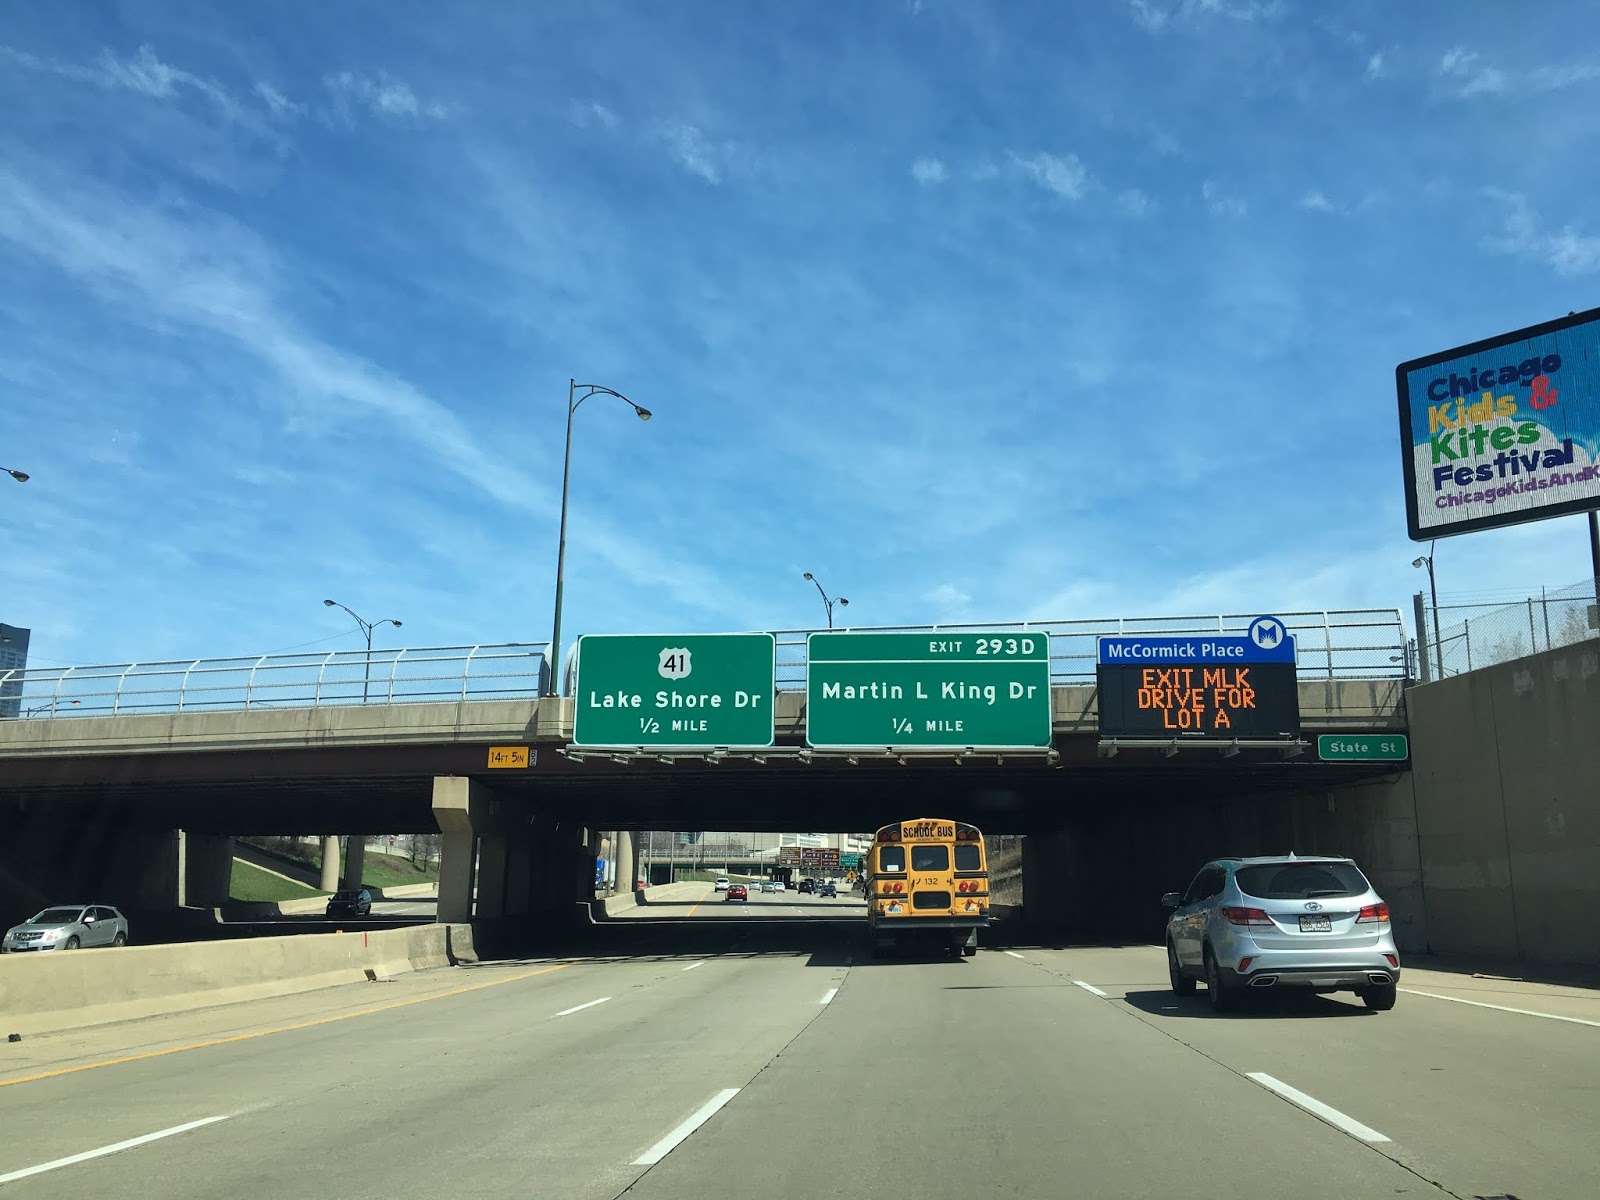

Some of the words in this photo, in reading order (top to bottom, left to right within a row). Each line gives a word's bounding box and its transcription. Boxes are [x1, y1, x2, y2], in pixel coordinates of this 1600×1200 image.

[1428, 354, 1561, 401] Chicago
[1428, 391, 1517, 434] Kids
[1529, 375, 1559, 410] &
[1430, 422, 1541, 465] Kites
[1433, 438, 1574, 491] Festival
[929, 641, 962, 653] EXIT
[975, 638, 1035, 655] 293D
[1108, 643, 1196, 658] McCormick
[1202, 643, 1244, 657] Place
[663, 654, 685, 672] 41
[1142, 668, 1193, 689] EXIT
[1203, 668, 1250, 689] MLK
[590, 691, 642, 708] Lake
[655, 691, 722, 708] Shore
[734, 691, 761, 708] Dr
[822, 681, 903, 699] Martin
[916, 682, 928, 699] L
[941, 681, 996, 706] King
[1009, 682, 1037, 699] Dr
[1137, 688, 1205, 709] DRIVE
[1214, 688, 1256, 709] FOR
[671, 720, 708, 731] MILE
[925, 720, 964, 732] MILE
[1164, 708, 1204, 729] LOT
[1214, 708, 1231, 729] A
[1330, 742, 1369, 753] State
[1380, 742, 1396, 753] St
[491, 751, 509, 763] 14FT
[511, 751, 525, 763] 5IN
[903, 826, 935, 838] SCHOOL
[937, 826, 953, 837] BUS
[924, 877, 938, 886] 132
